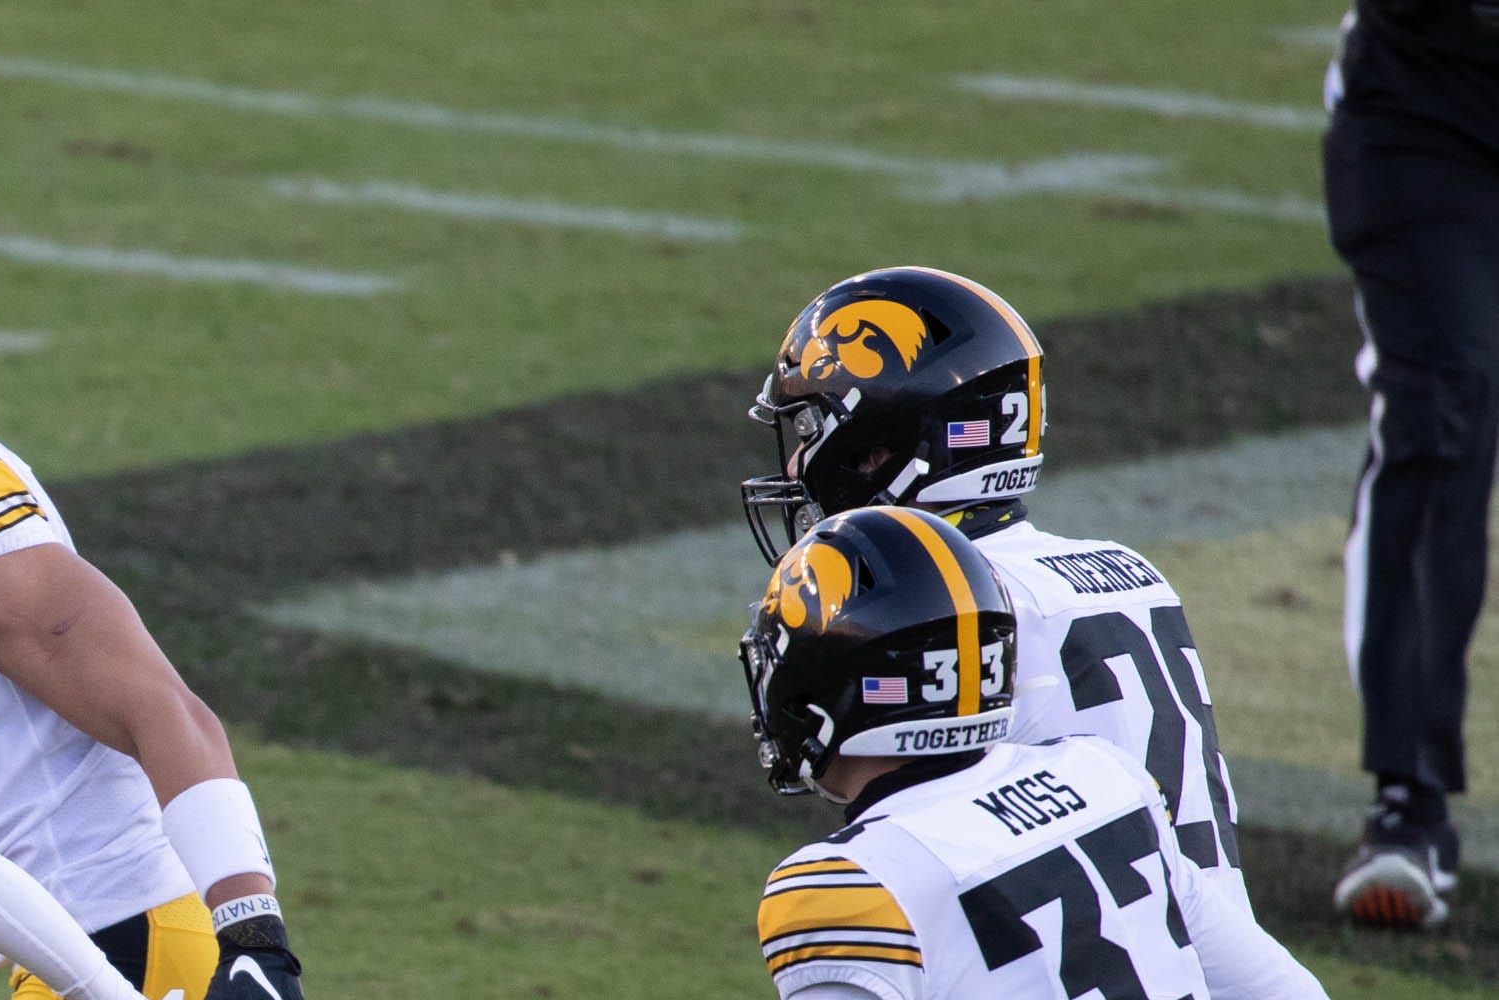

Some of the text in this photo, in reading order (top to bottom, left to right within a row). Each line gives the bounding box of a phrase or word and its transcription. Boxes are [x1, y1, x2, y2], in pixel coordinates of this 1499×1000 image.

[980, 464, 1043, 495] TOGET
[1034, 550, 1163, 594] KOERNER
[922, 641, 1005, 703] 33
[894, 718, 1008, 752] TOGETHER
[972, 770, 1088, 837] MOSS
